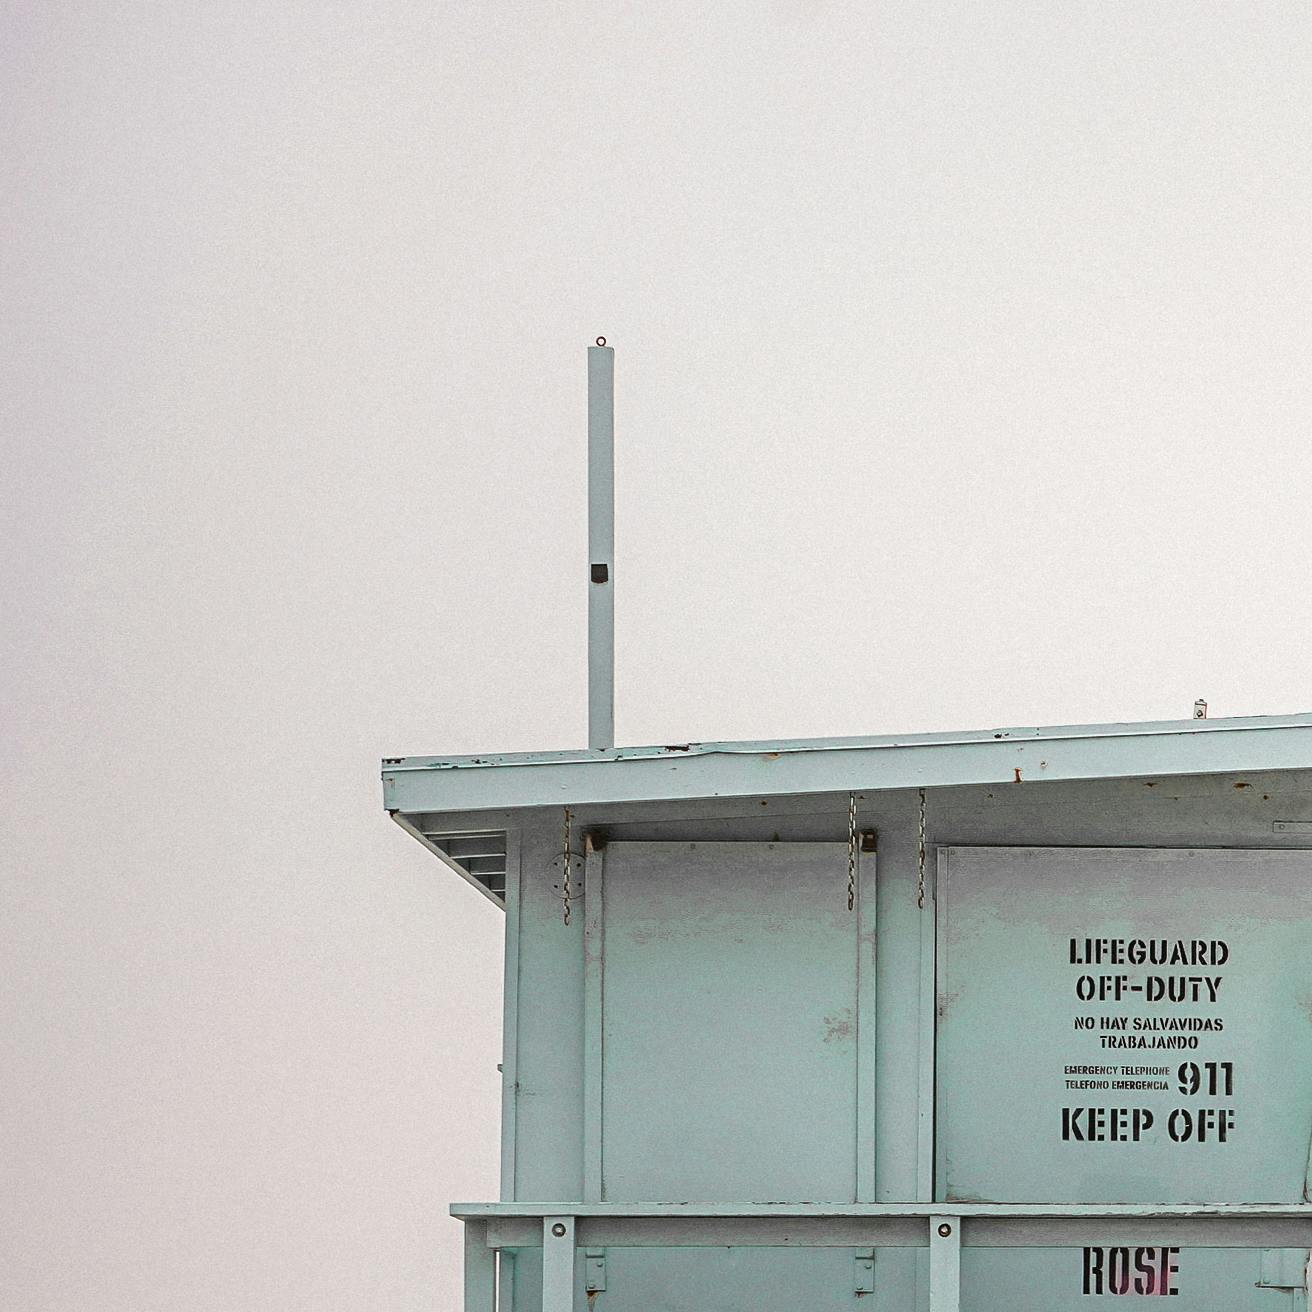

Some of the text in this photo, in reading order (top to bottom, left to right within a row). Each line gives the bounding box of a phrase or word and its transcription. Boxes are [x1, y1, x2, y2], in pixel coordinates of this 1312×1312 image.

[1069, 938, 1229, 966] LIFEGUARD
[1076, 975, 1223, 1003] OFF-DUTY
[1074, 1016, 1224, 1032] NO HAY SALVAVIDAS
[1099, 1035, 1199, 1050] TRABAJANDO
[1064, 1065, 1170, 1076] EMERGENCY TELEPHONE
[1177, 1061, 1233, 1096] 911
[1065, 1079, 1169, 1091] TELEFONO EMERGENCIA
[1061, 1107, 1235, 1143] KEEP OFF
[1083, 1246, 1180, 1296] ROSE
